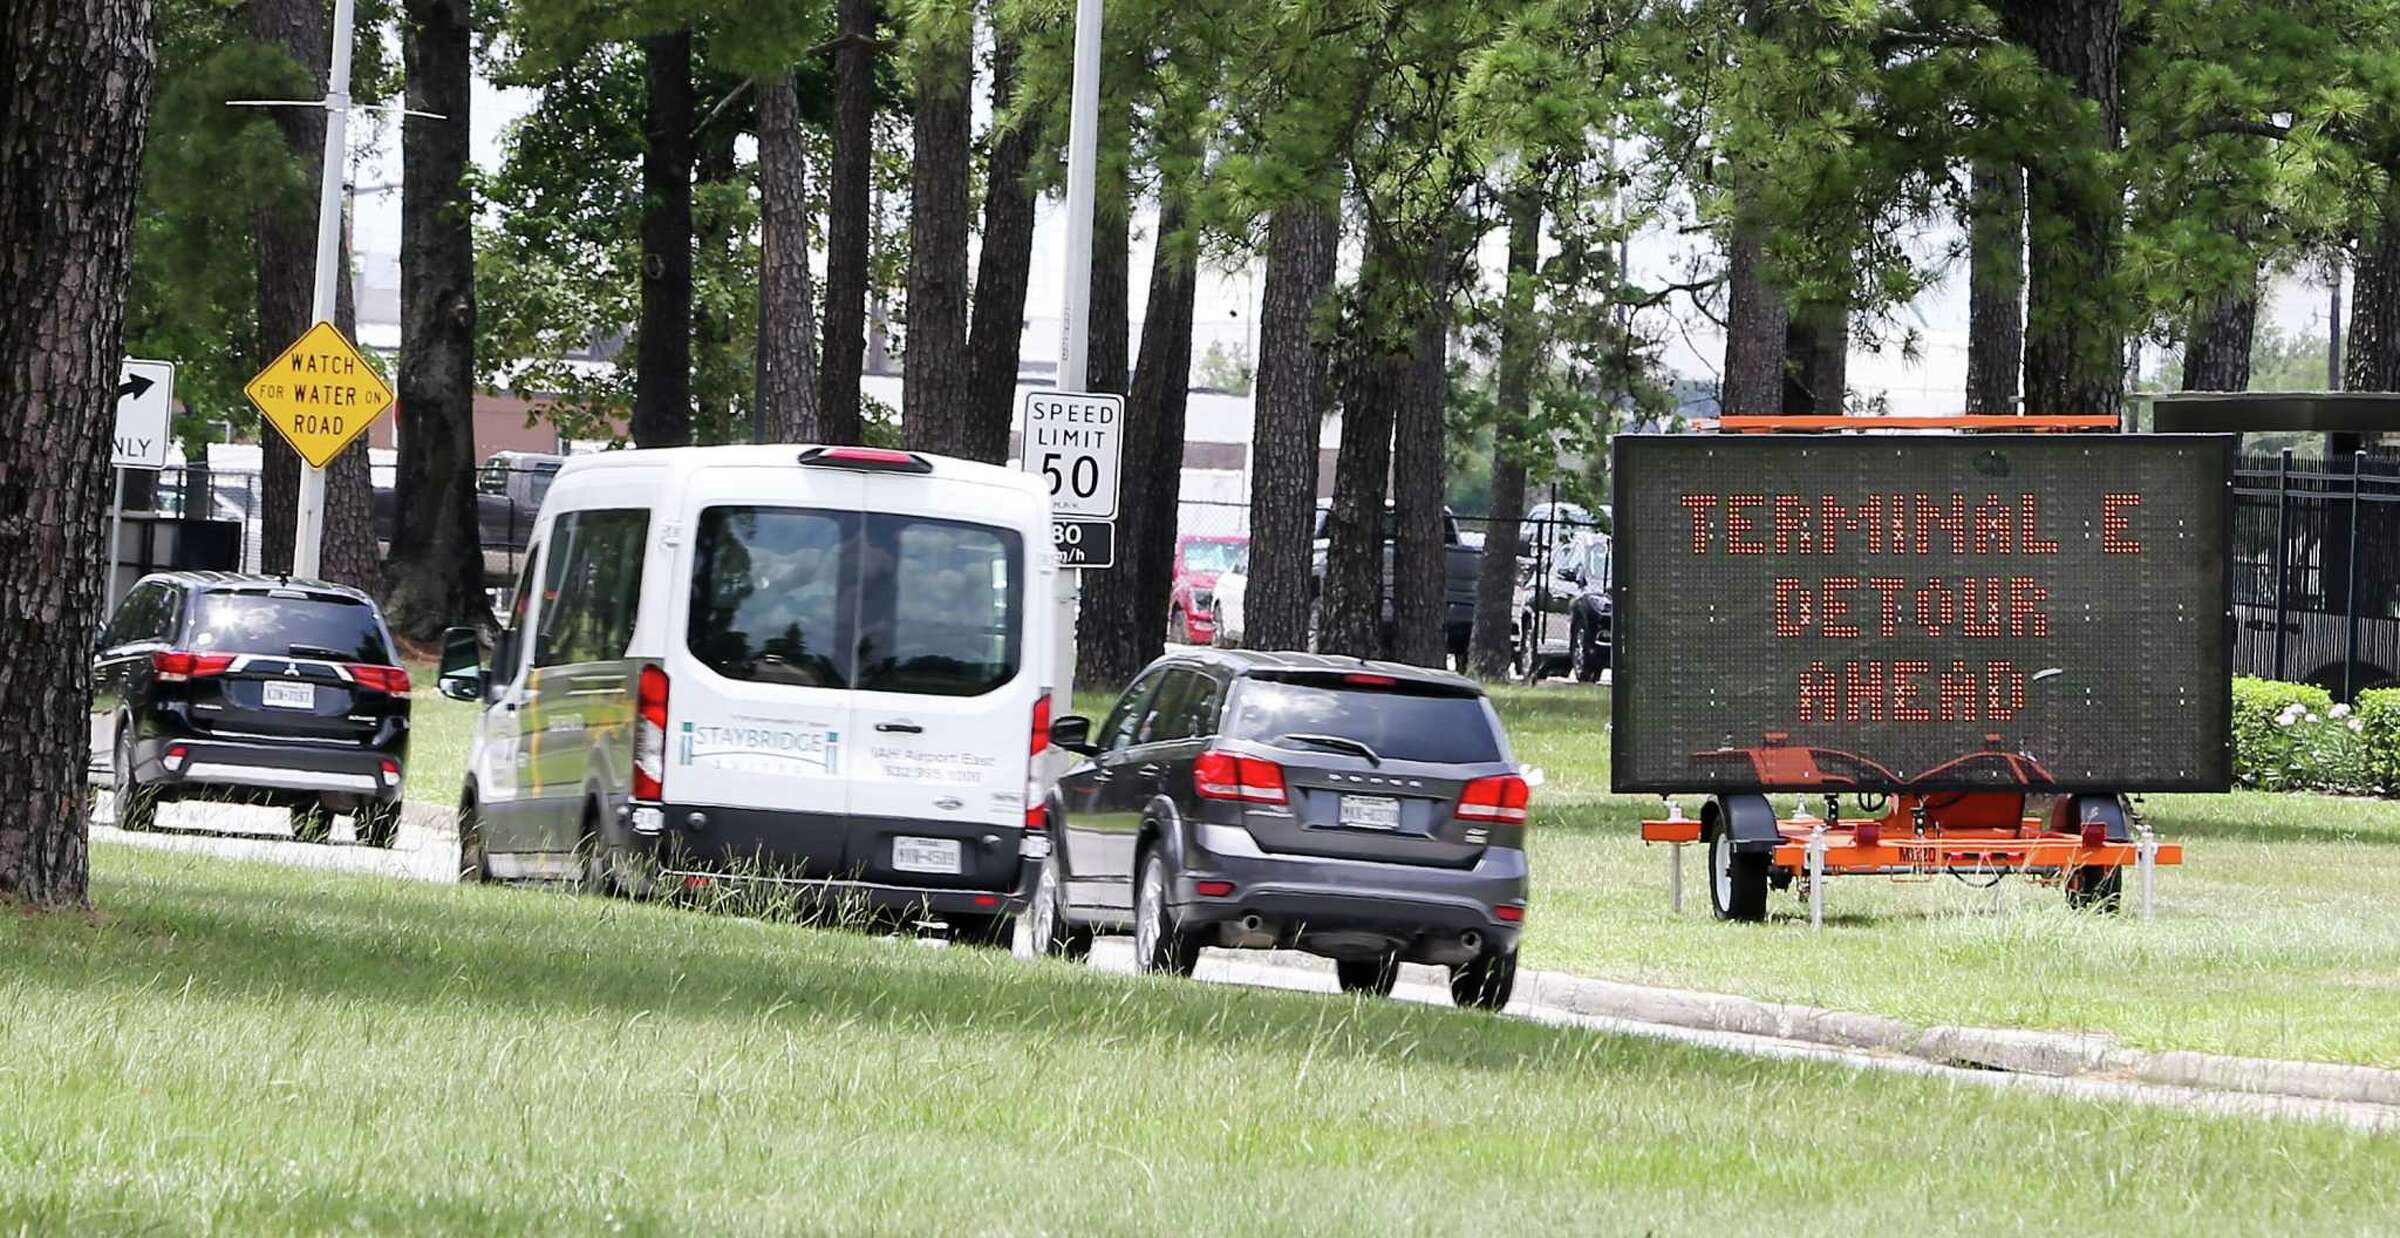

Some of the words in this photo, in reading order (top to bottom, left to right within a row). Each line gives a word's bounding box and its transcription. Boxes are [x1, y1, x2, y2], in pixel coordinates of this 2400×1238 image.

[292, 352, 355, 375] WATCH
[260, 384, 284, 399] FOR
[295, 384, 356, 407] WATER
[365, 390, 381, 404] ON
[294, 414, 344, 435] ROAD
[1033, 402, 1113, 424] SPEED
[113, 436, 152, 458] NLY
[1038, 428, 1105, 449] LIMIT
[1042, 452, 1099, 498] 50
[1052, 524, 1082, 545] 80
[1681, 493, 2059, 555] TERMINAL
[2103, 493, 2142, 554] E
[1775, 576, 2047, 638] DETOUR
[1799, 660, 2025, 722] AHEAD
[695, 726, 823, 752] STAYBRIDGE
